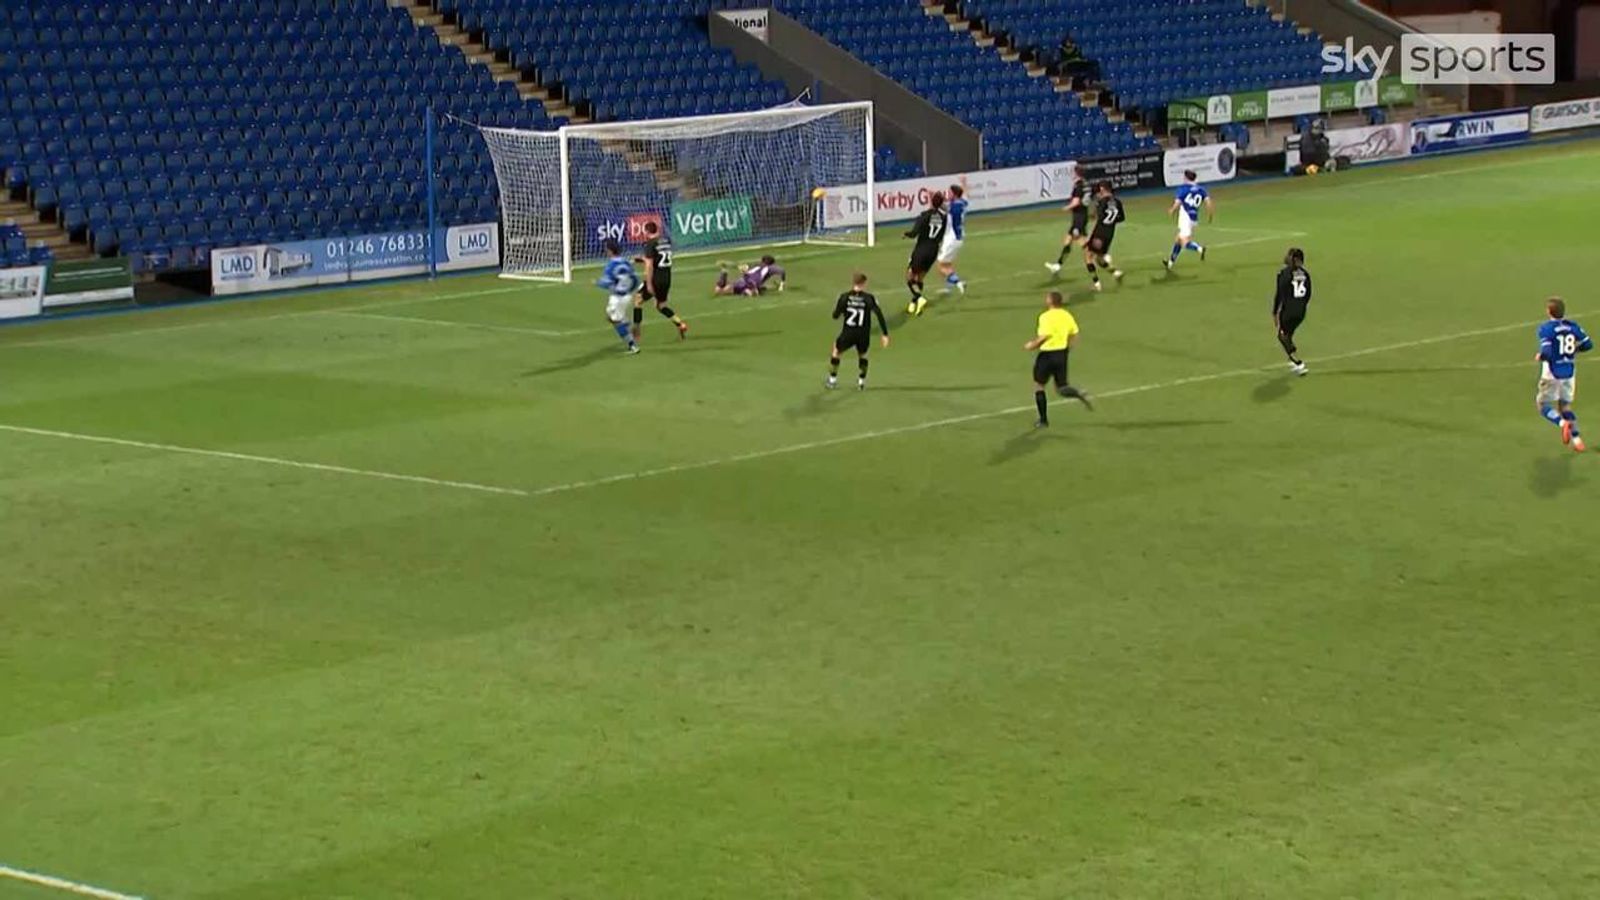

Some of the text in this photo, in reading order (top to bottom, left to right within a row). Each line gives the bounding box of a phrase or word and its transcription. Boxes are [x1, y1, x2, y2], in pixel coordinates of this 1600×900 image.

[877, 191, 915, 211] Kirby
[1184, 192, 1203, 208] 40
[676, 207, 738, 235] Vertu
[1103, 207, 1119, 224] 27
[597, 219, 625, 242] sky
[929, 223, 942, 239] 17
[326, 233, 432, 258] 01246 768331
[459, 232, 487, 249] LMD
[221, 256, 253, 274] LMD
[657, 250, 673, 267] 23
[1291, 280, 1307, 298] 16
[846, 307, 865, 327] 21
[1556, 334, 1575, 355] 18
